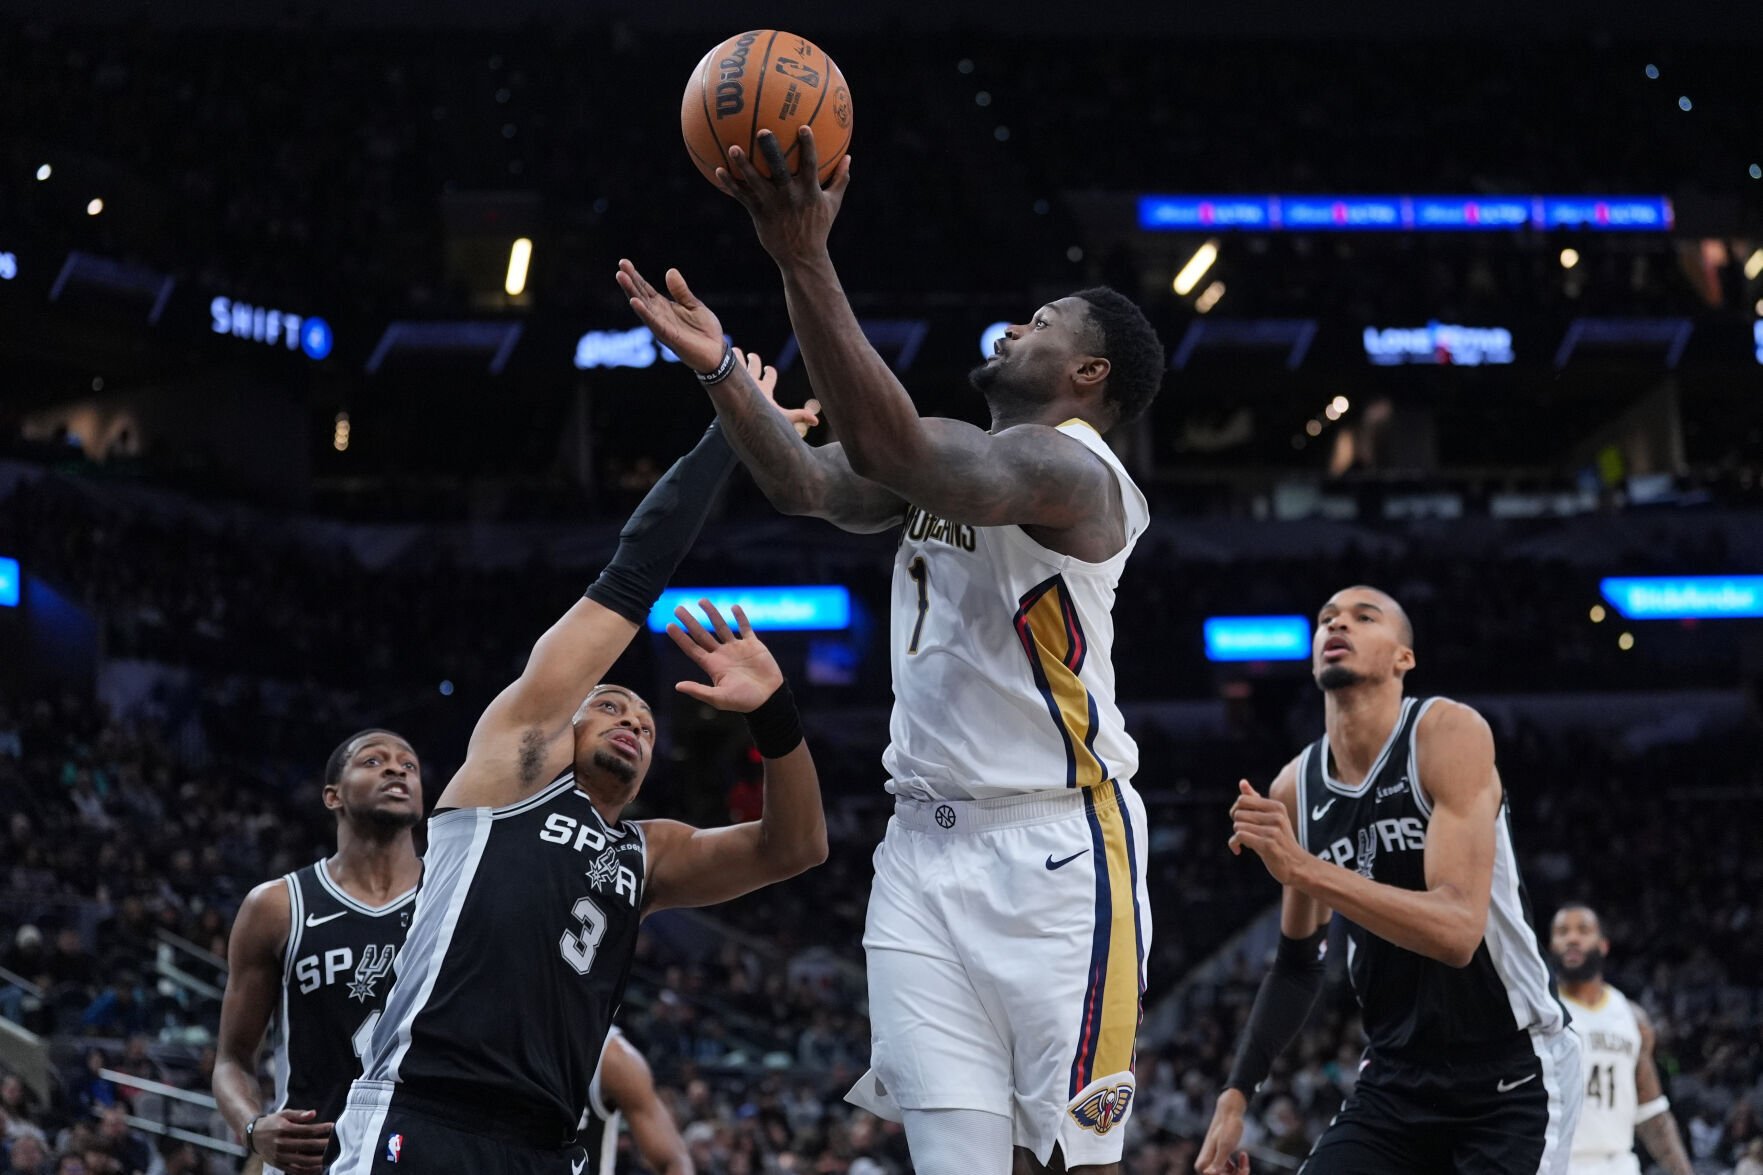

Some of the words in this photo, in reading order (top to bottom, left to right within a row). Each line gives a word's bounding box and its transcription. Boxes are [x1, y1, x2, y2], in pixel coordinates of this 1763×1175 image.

[210, 295, 303, 351] SHIFT
[907, 556, 929, 655] 1
[558, 895, 608, 976] 3
[1587, 1064, 1615, 1109] 41
